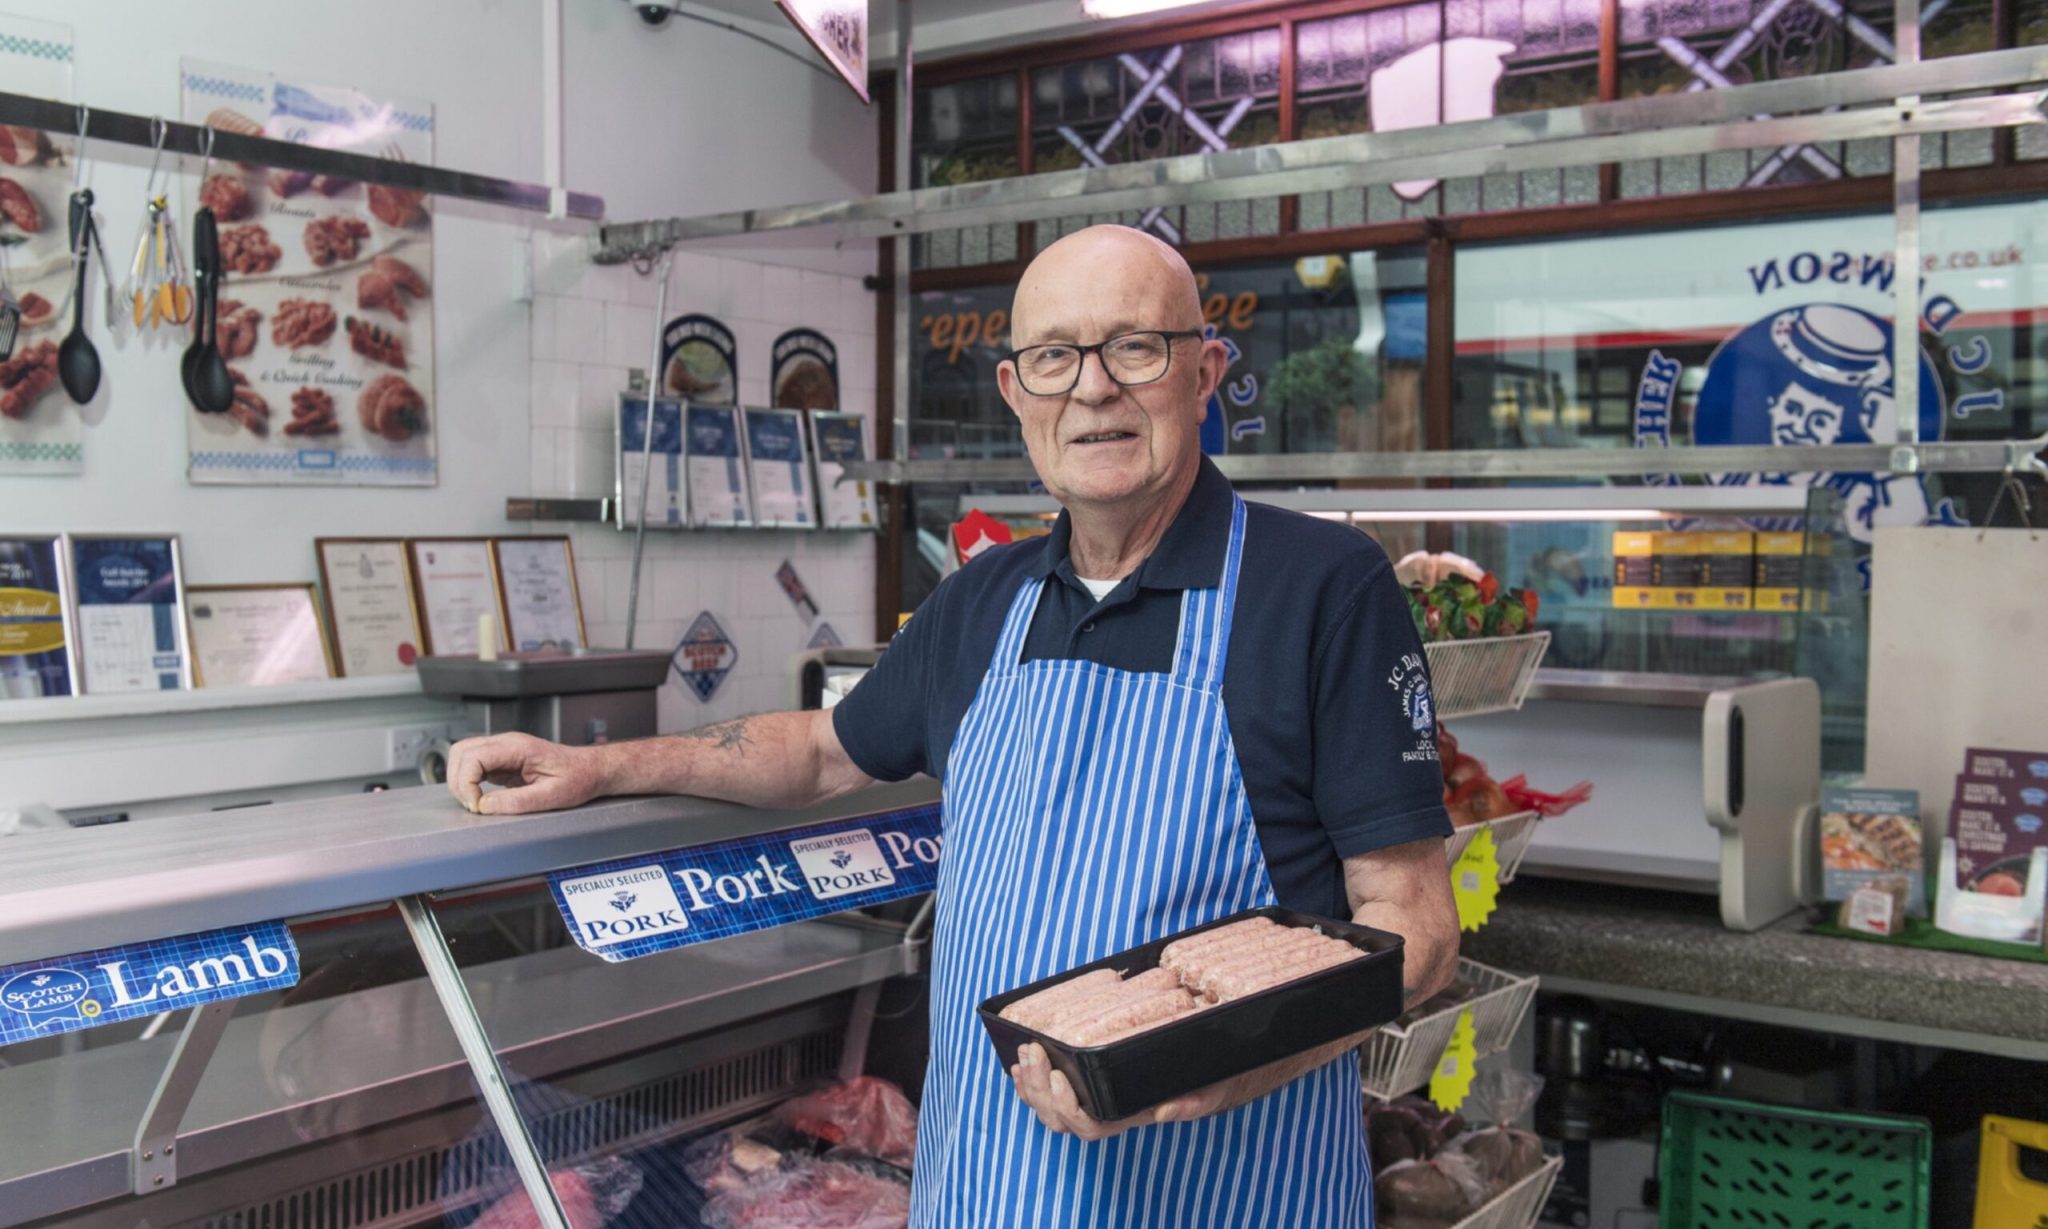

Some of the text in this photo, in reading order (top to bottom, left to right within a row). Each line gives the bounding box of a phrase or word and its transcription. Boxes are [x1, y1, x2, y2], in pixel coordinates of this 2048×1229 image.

[794, 832, 872, 854] SPECIALLY SELECTED
[879, 831, 944, 870] Po
[564, 870, 664, 896] SPECIALLY SELECTED
[673, 854, 801, 912] Pork
[812, 867, 890, 895] PORK
[583, 909, 684, 942] PORK
[96, 935, 289, 1009] Lamb
[6, 982, 82, 1004] SCOTCH
[22, 992, 75, 1011] LAMB
